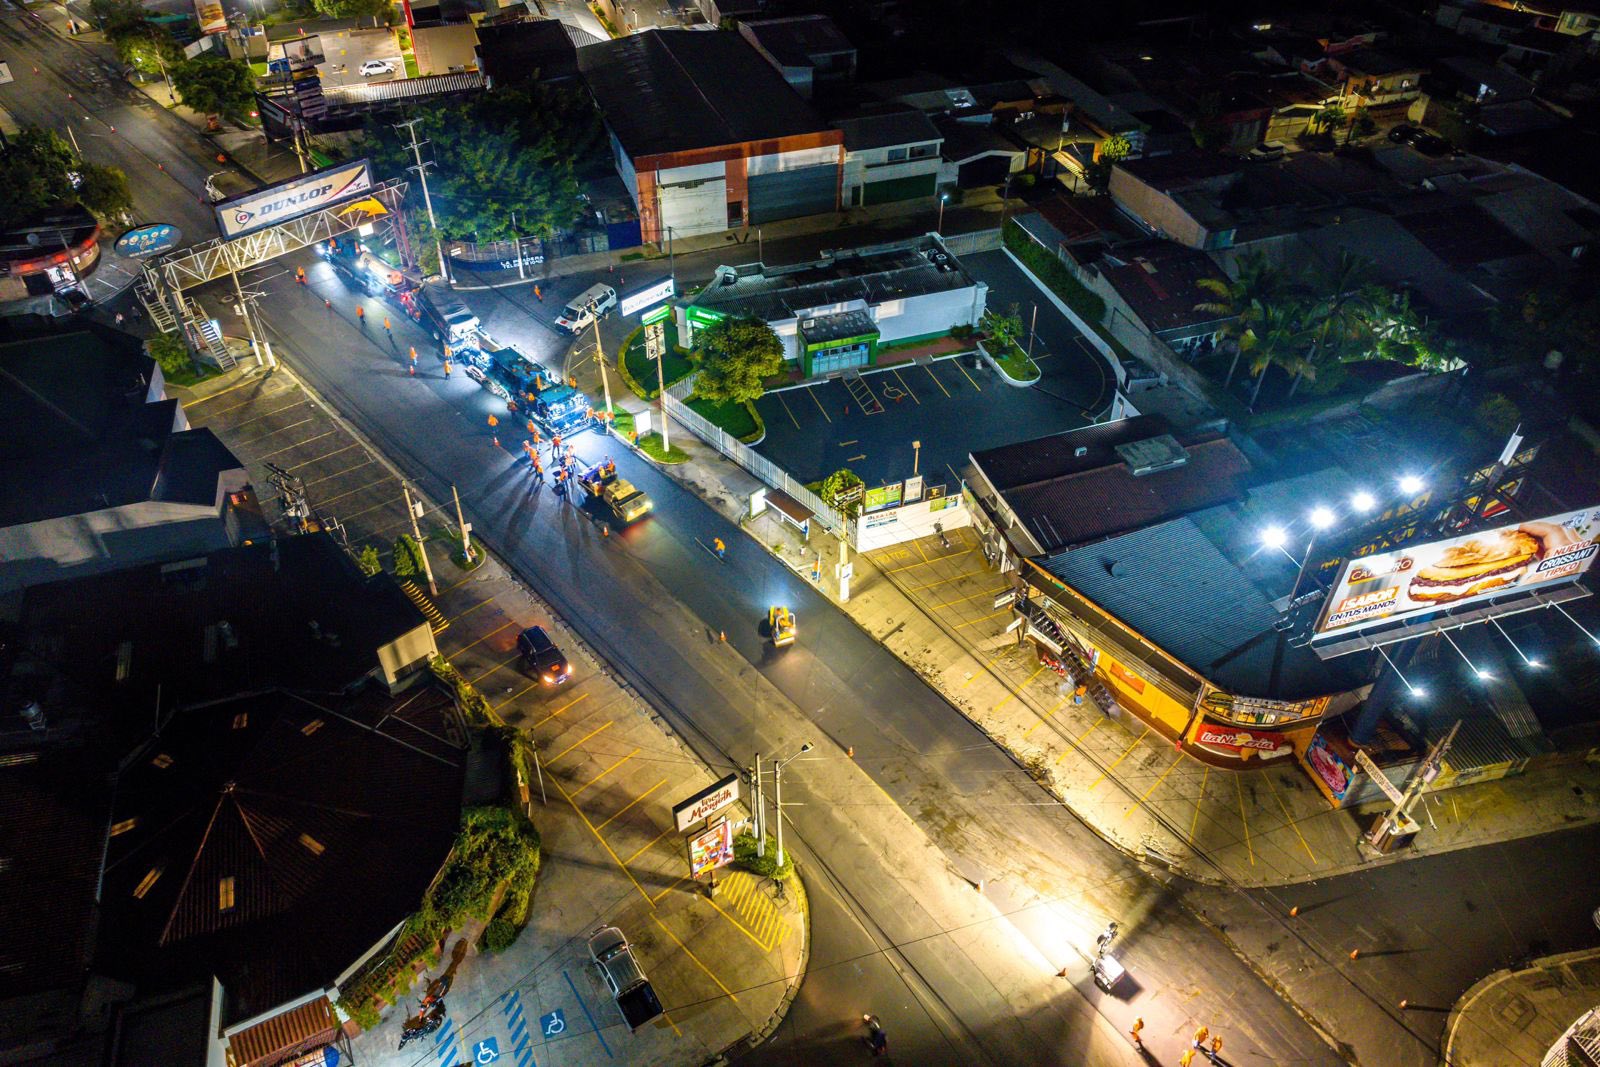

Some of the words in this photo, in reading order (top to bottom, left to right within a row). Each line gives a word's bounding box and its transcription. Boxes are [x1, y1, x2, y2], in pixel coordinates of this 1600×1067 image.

[259, 184, 333, 216] DUNLOP
[512, 255, 544, 265] PADERA
[1541, 547, 1594, 570] CROISSANT
[1555, 540, 1591, 555] NUEVO
[1329, 613, 1342, 622] EN
[1342, 608, 1361, 618] TUS
[1362, 599, 1397, 614] MANOS
[688, 789, 732, 822] Margoth
